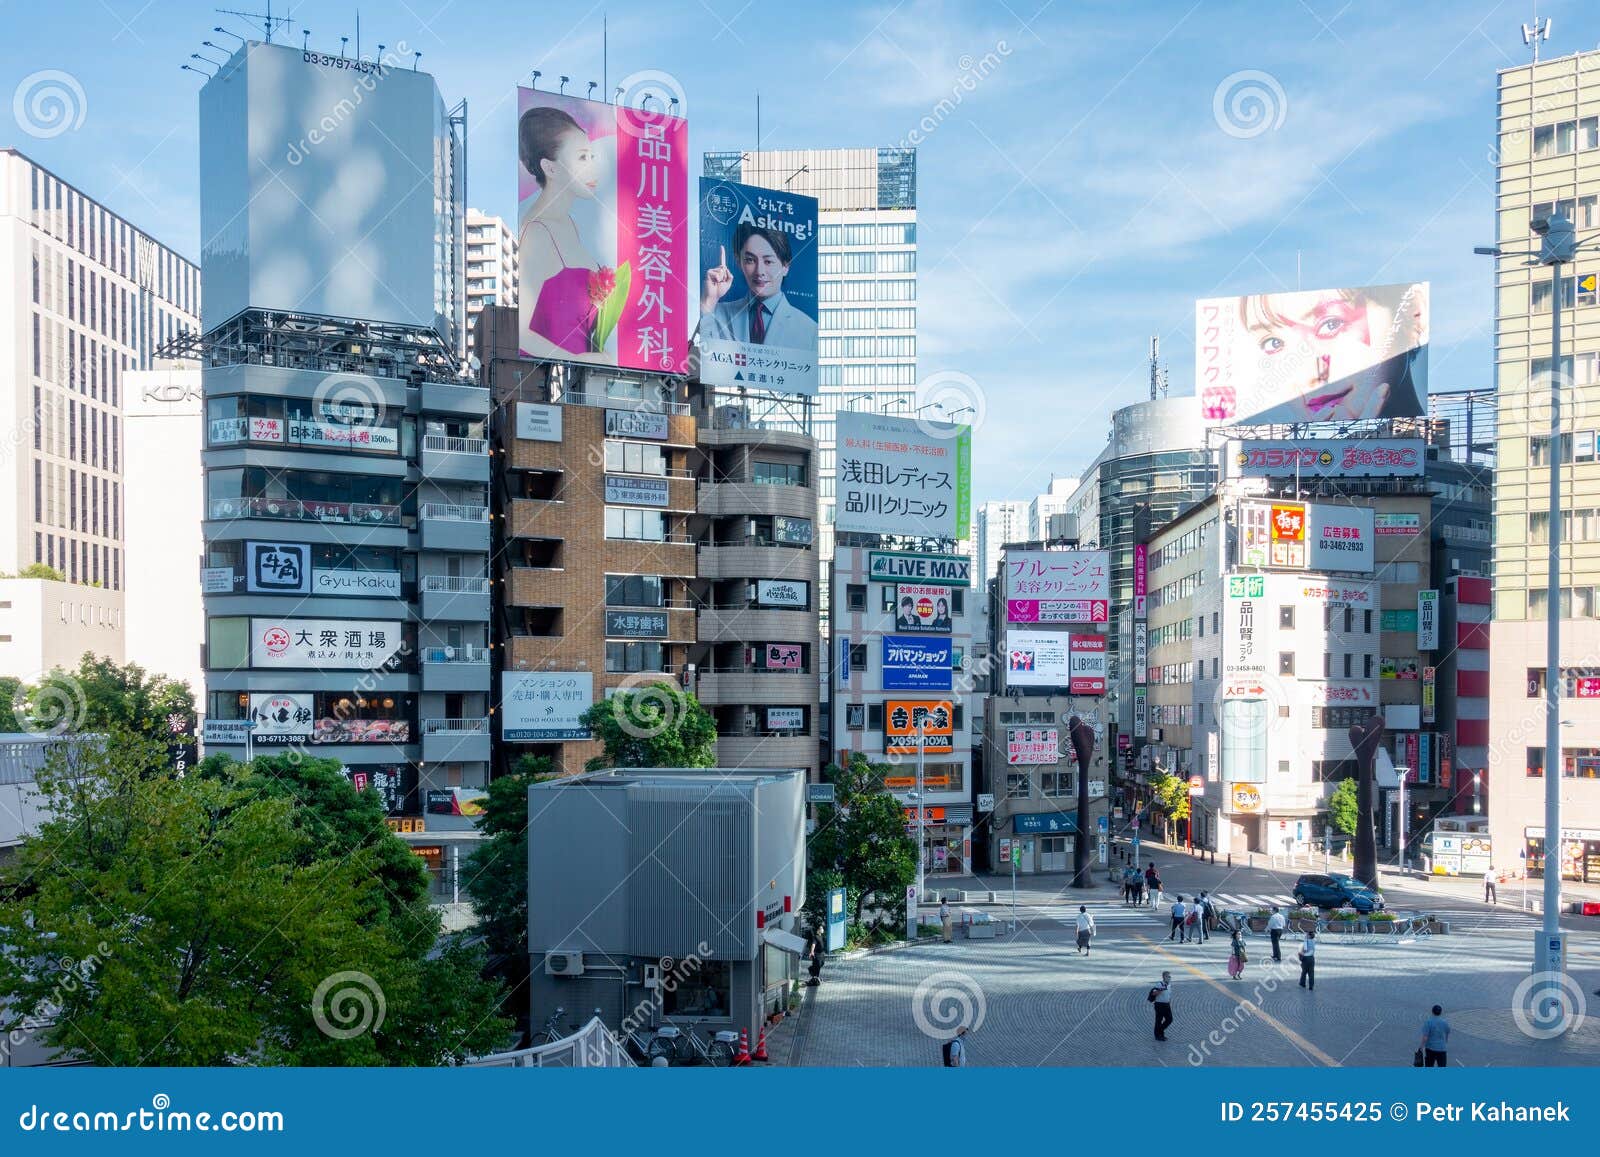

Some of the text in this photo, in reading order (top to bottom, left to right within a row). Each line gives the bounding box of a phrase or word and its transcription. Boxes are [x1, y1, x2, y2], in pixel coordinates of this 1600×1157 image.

[757, 195, 794, 216] なんでも
[738, 204, 813, 241] Asking!
[636, 122, 673, 366] 品川美容外科
[1202, 306, 1220, 383] ワクワク
[710, 351, 733, 365] AGA
[748, 357, 812, 372] スキンクリニック
[747, 372, 785, 386] 直進1分
[252, 430, 280, 440] マグロ
[290, 425, 370, 444] 日本酒飲み放題
[1247, 446, 1418, 469] カラオケ まねきねこ
[841, 458, 953, 490] 浅田レディース
[845, 491, 948, 519] 品川クリニック
[1323, 527, 1360, 540] 広告募集
[1319, 541, 1364, 552] 03-3462-2933
[262, 553, 299, 580] 牛角
[931, 561, 969, 579] MAX
[319, 574, 397, 590] Gyu-Kaku
[1015, 580, 1101, 594] 美容クリニック
[1230, 576, 1264, 598] 透析
[613, 615, 665, 630] 水野歯科
[294, 629, 387, 649] 大衆酒場
[887, 649, 948, 664] アパマンショップ
[519, 678, 577, 689] マンションの
[1226, 686, 1245, 696] 入口
[513, 690, 583, 702] 売却・購入専門
[257, 735, 306, 743] 03-6712-3083
